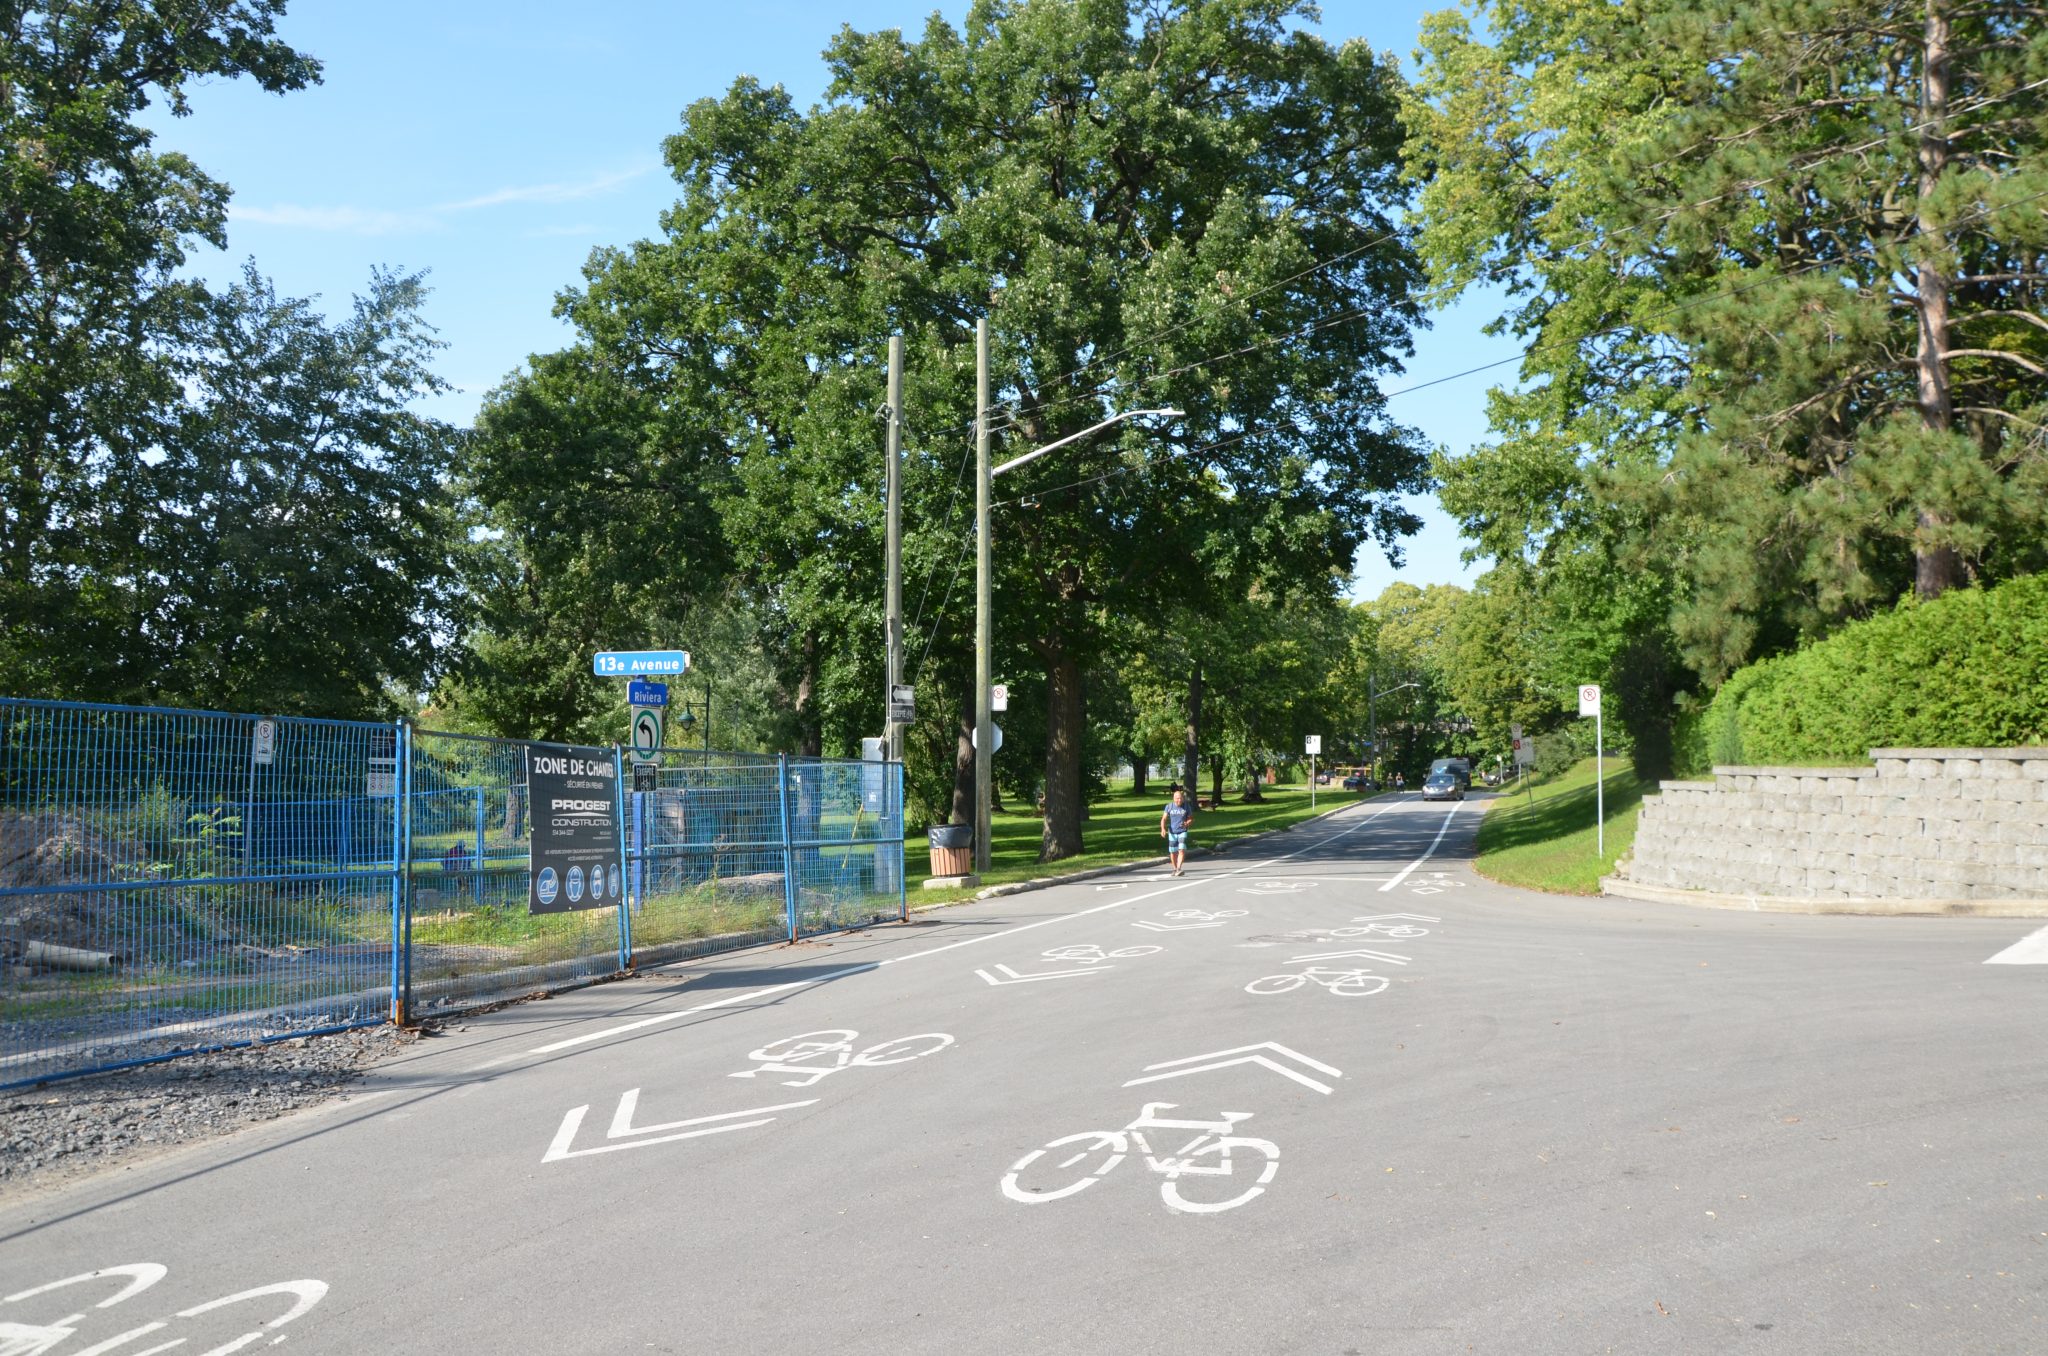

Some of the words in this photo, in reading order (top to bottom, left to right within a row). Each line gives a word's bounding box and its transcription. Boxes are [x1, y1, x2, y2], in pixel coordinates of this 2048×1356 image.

[599, 657, 625, 671] 13e
[631, 660, 680, 671] Avenue
[634, 691, 662, 703] Riviera
[534, 757, 567, 775] ZONE
[571, 759, 585, 776] DE
[586, 760, 614, 779] CHANTIER
[552, 800, 611, 811] PROGEST
[552, 819, 612, 827] CONSTRUCTION
